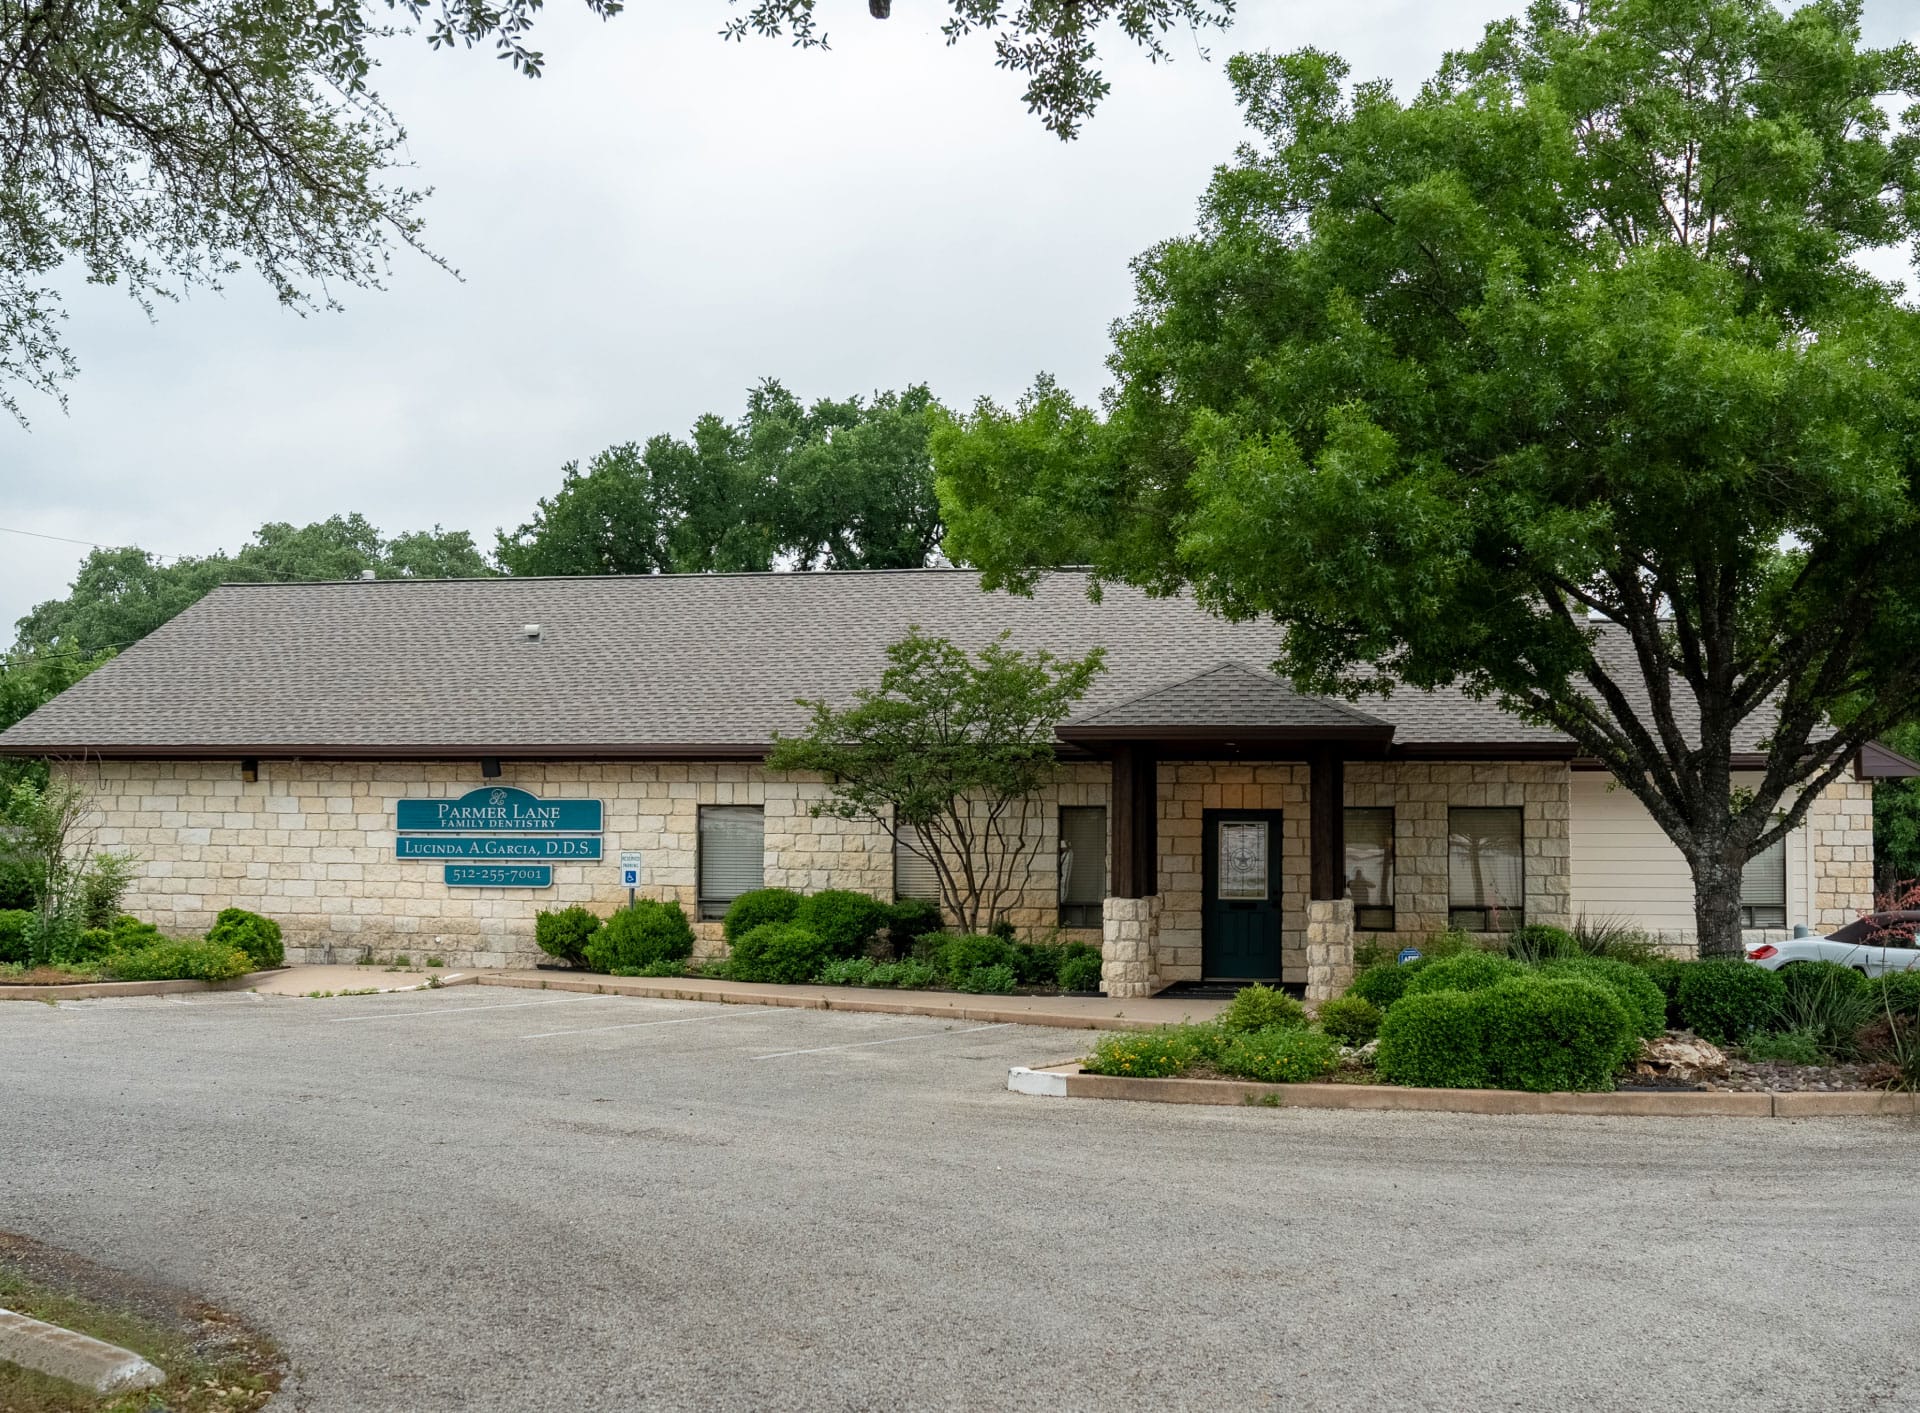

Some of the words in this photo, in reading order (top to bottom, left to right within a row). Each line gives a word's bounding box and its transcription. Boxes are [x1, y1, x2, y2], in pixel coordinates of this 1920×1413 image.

[437, 803, 507, 819] PARMER
[513, 803, 561, 819] LANE
[441, 819, 484, 828] FAMILY
[489, 819, 556, 828] DENTISTRY
[404, 840, 464, 854] LUCINDA
[546, 840, 592, 855] D.D.S.
[453, 869, 542, 882] 512-255-7001
